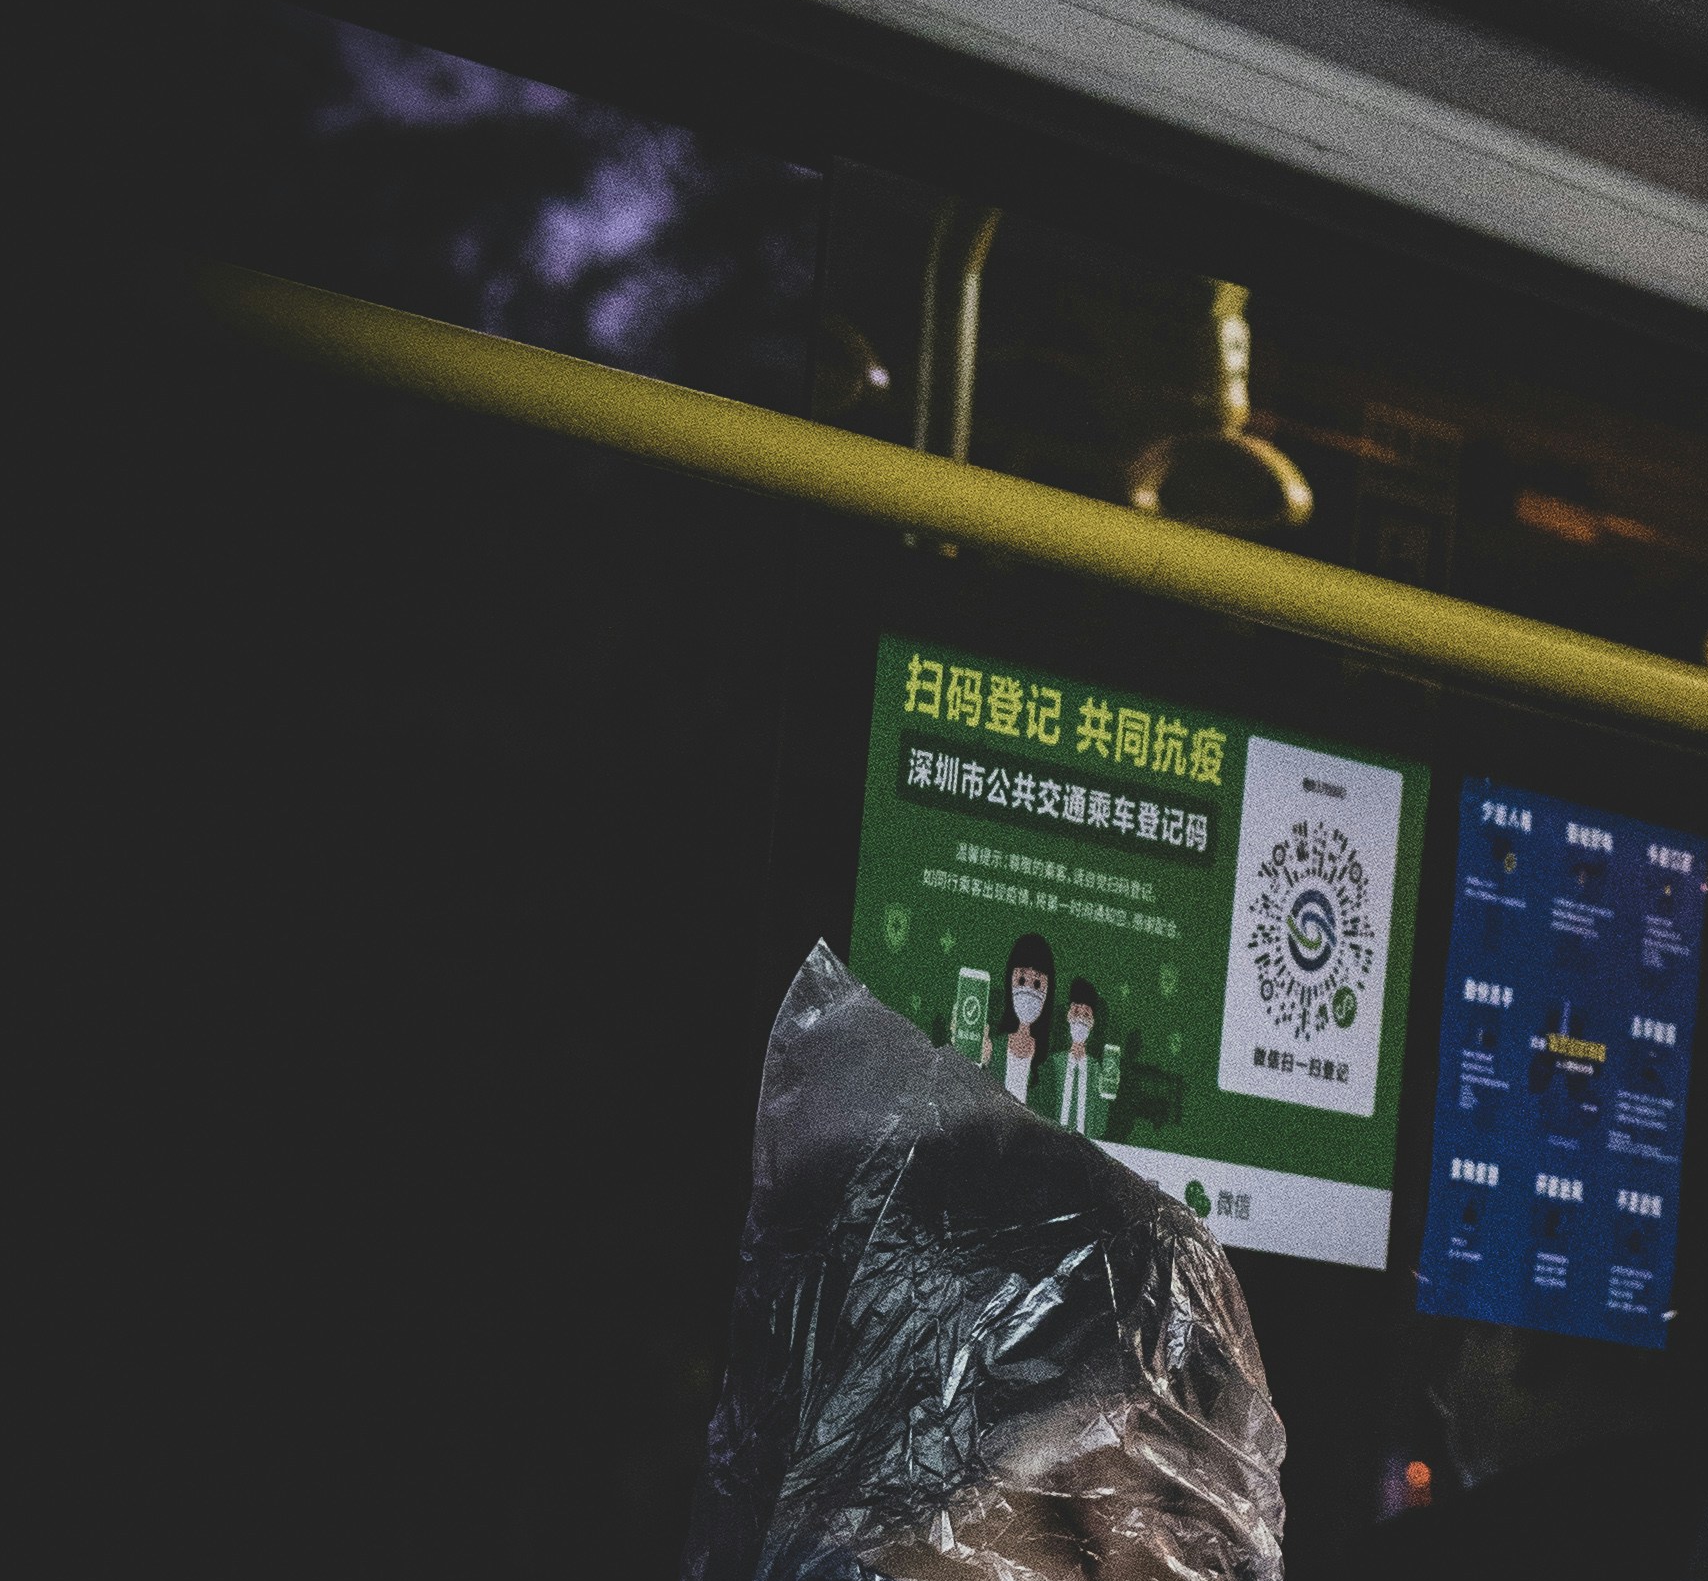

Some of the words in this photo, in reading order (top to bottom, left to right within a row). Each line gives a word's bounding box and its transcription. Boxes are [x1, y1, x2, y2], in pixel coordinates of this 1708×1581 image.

[905, 653, 1062, 746] 扫码登记
[1077, 697, 1228, 787] 共同抗疫
[906, 746, 1209, 854] 深圳市公共交通乘车登记码
[1253, 1046, 1350, 1084] 微信扫一扫登记
[1217, 1189, 1252, 1221] 微信
